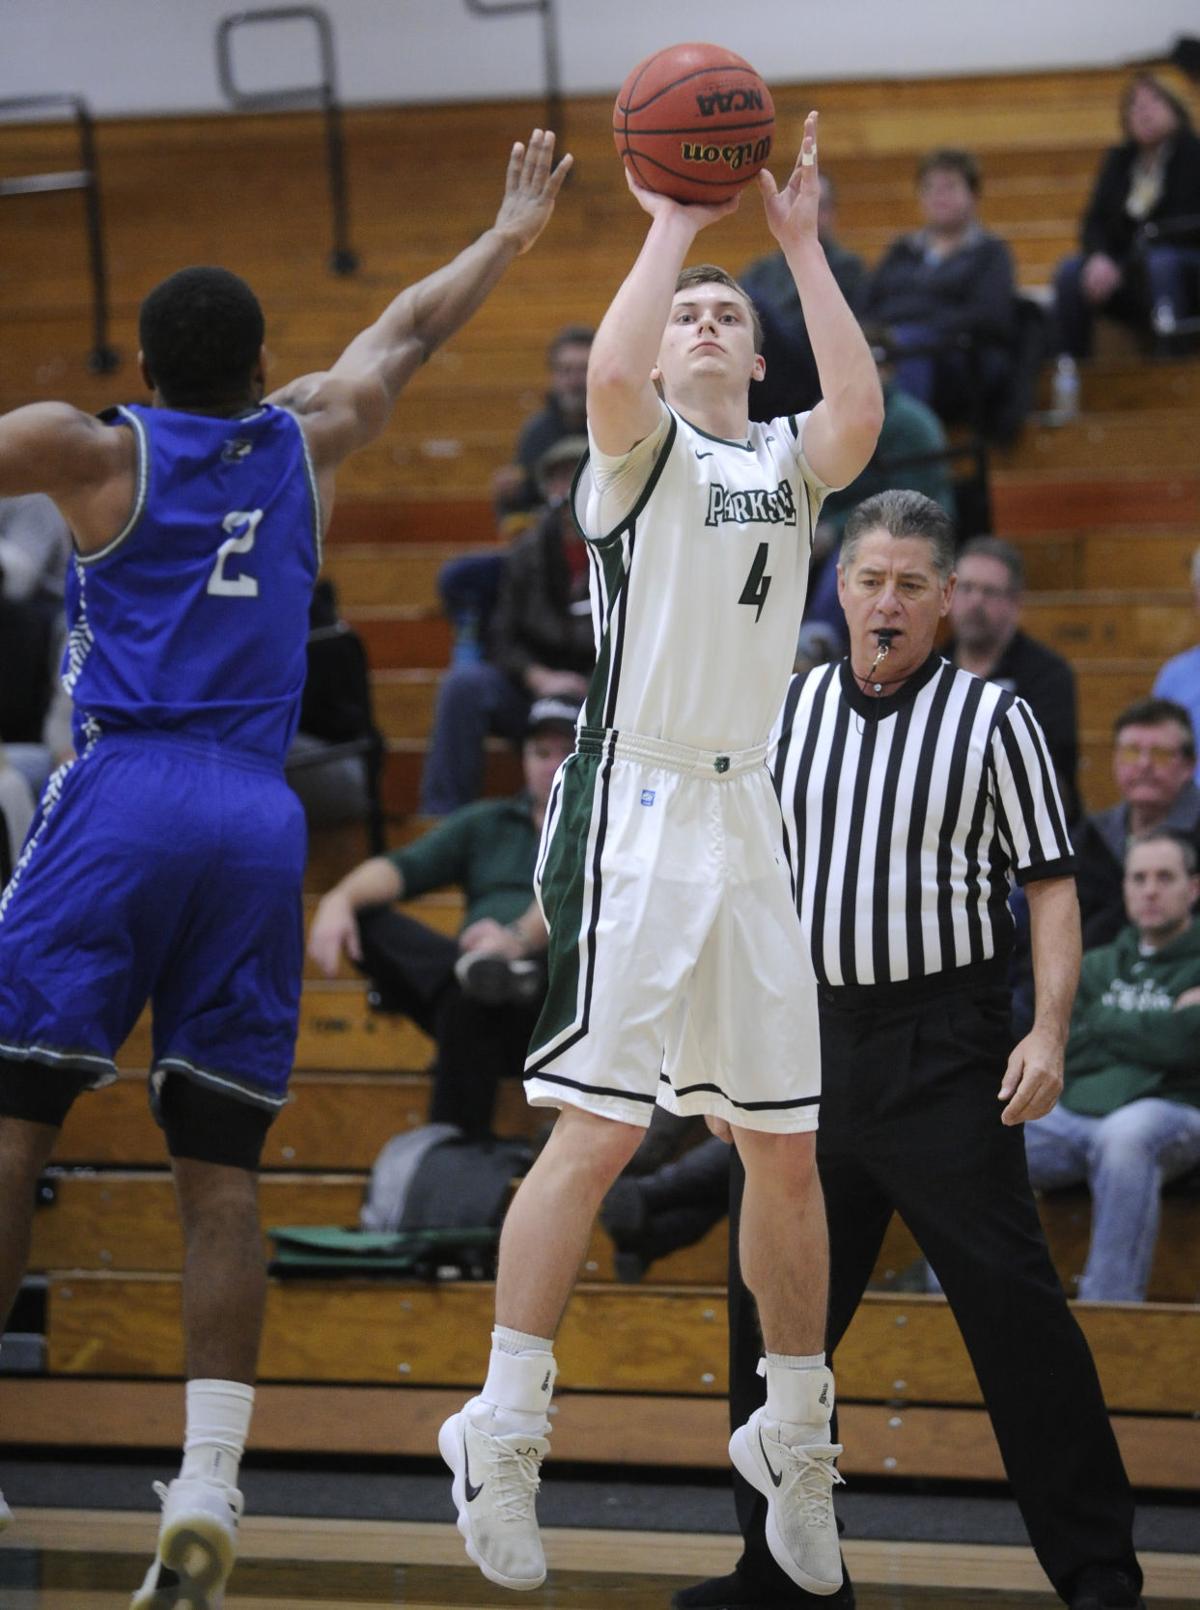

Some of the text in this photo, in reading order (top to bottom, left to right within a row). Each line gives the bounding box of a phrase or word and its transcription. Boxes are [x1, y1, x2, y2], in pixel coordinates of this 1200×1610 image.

[696, 90, 764, 116] NCAA
[682, 136, 770, 168] Wilson
[207, 509, 263, 596] 2
[738, 542, 772, 623] 4
